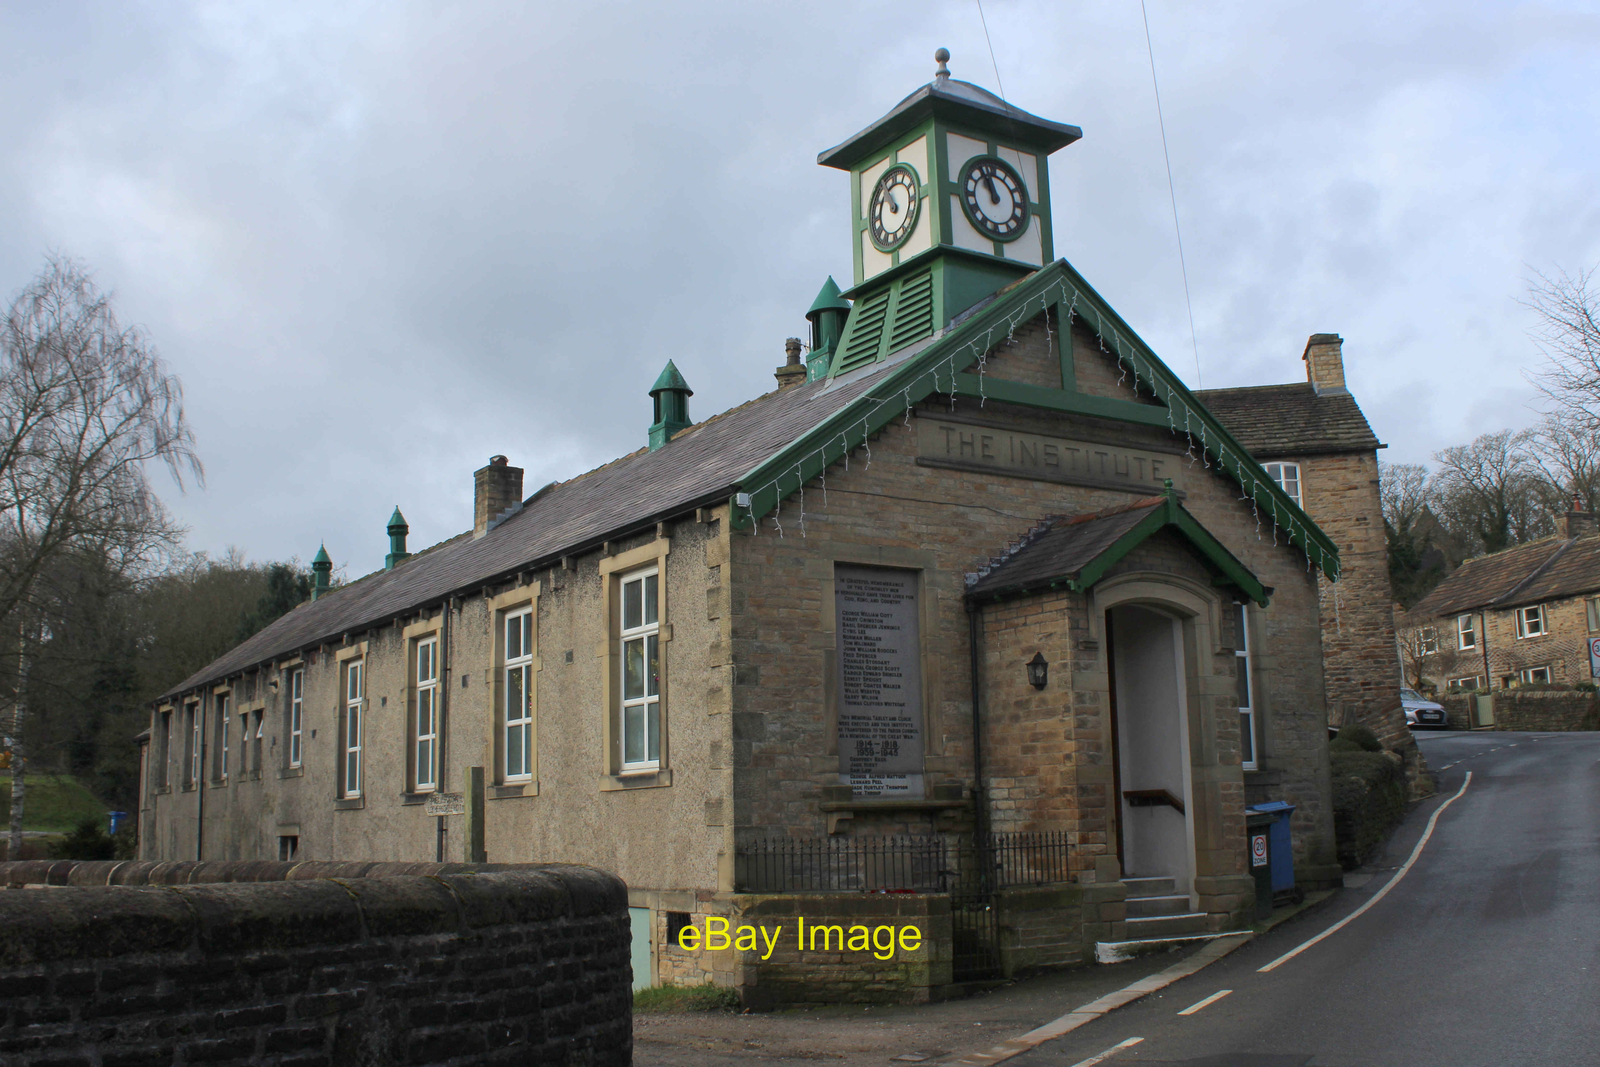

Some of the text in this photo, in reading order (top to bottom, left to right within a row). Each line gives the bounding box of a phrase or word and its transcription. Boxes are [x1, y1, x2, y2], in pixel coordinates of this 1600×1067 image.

[939, 425, 1165, 482] THE INSTITUTE
[1256, 842, 1264, 851] 20
